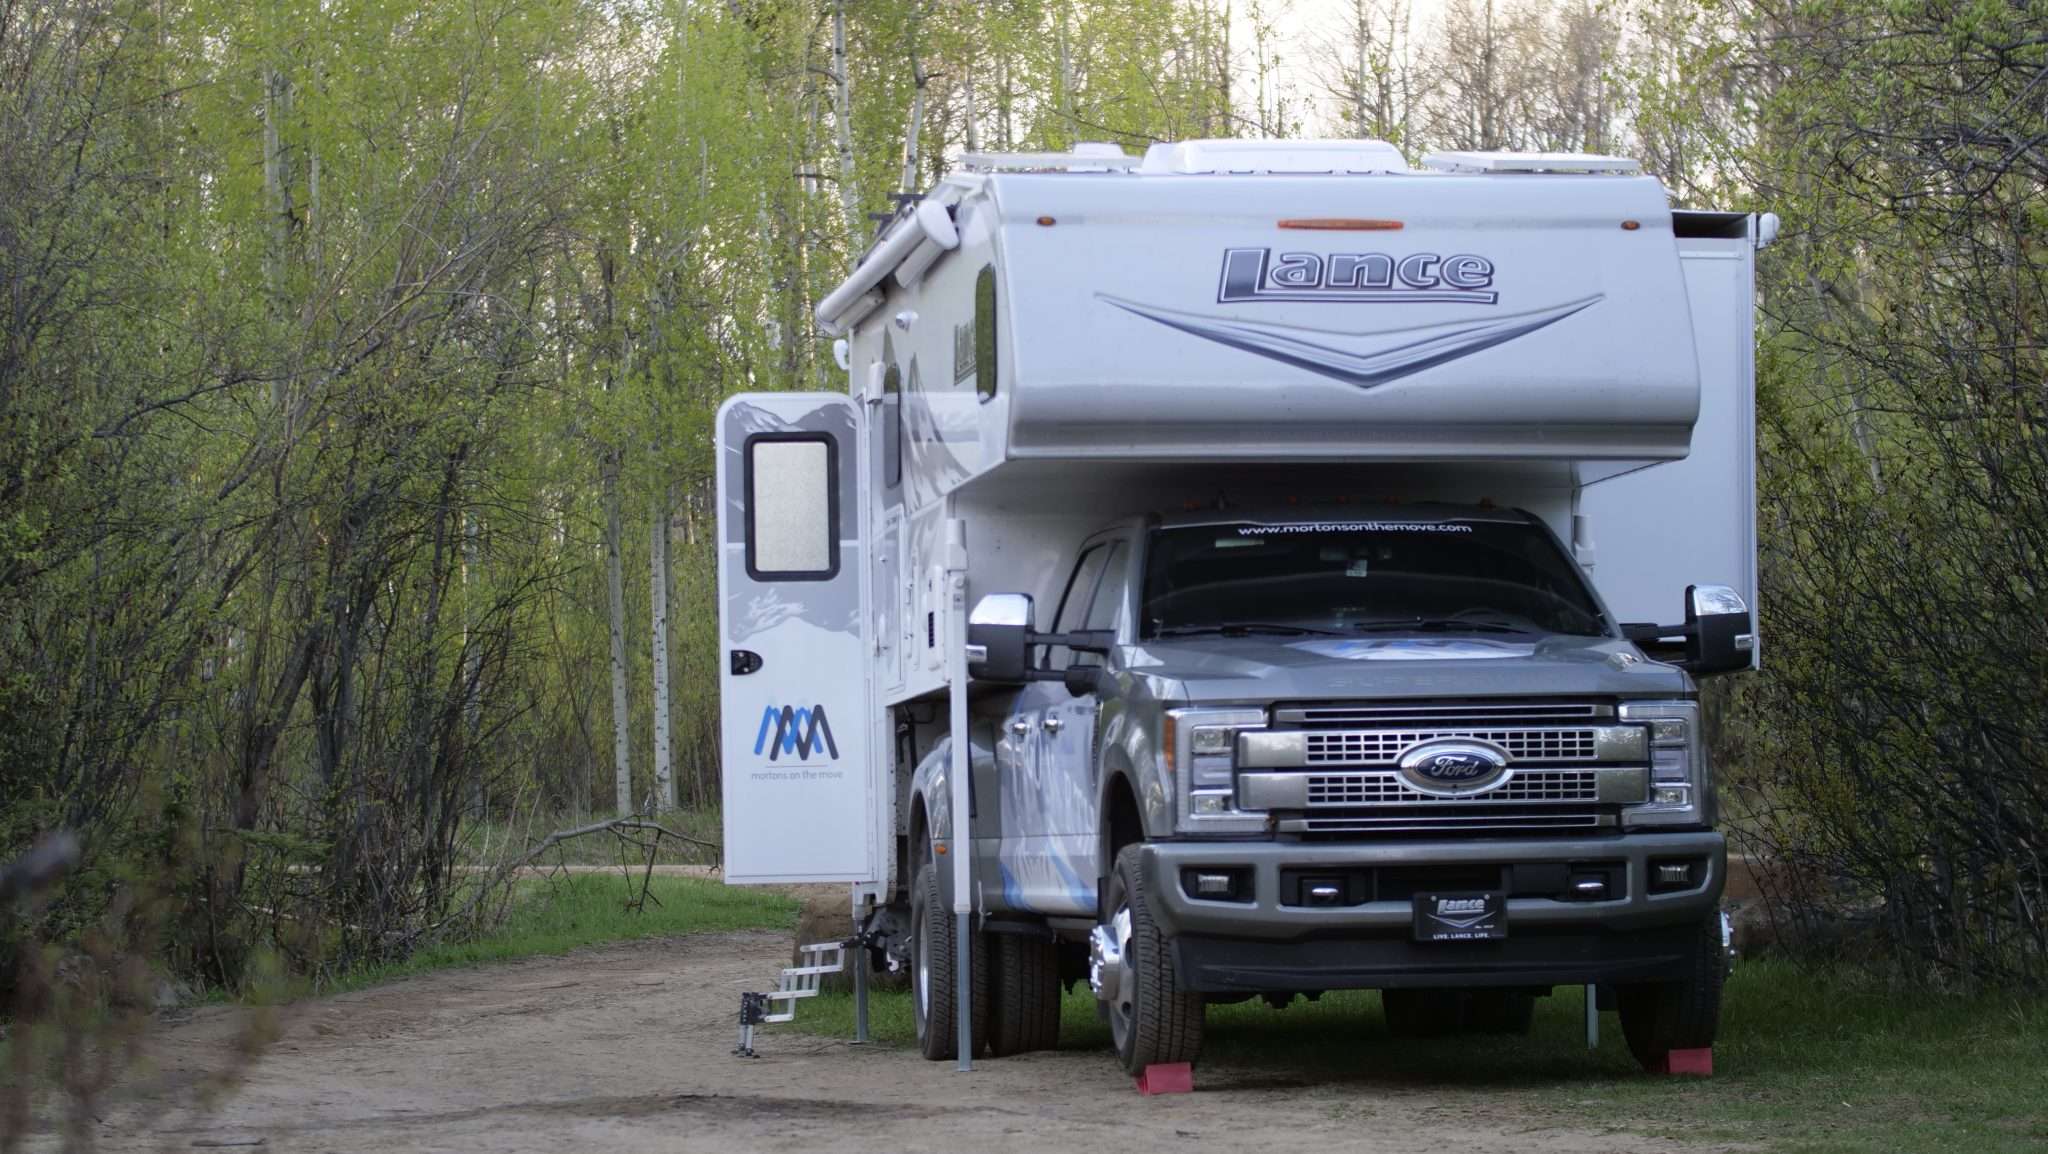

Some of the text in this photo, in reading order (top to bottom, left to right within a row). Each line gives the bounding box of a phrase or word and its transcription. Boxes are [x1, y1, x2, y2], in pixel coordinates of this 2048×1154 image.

[1217, 247, 1499, 304] Lance
[1238, 522, 1473, 535] www.mortonsonthemove.com
[1431, 755, 1480, 777] Ford
[790, 772, 800, 780] on
[802, 770, 816, 780] the
[819, 771, 844, 779] move
[1437, 899, 1485, 915] Lance
